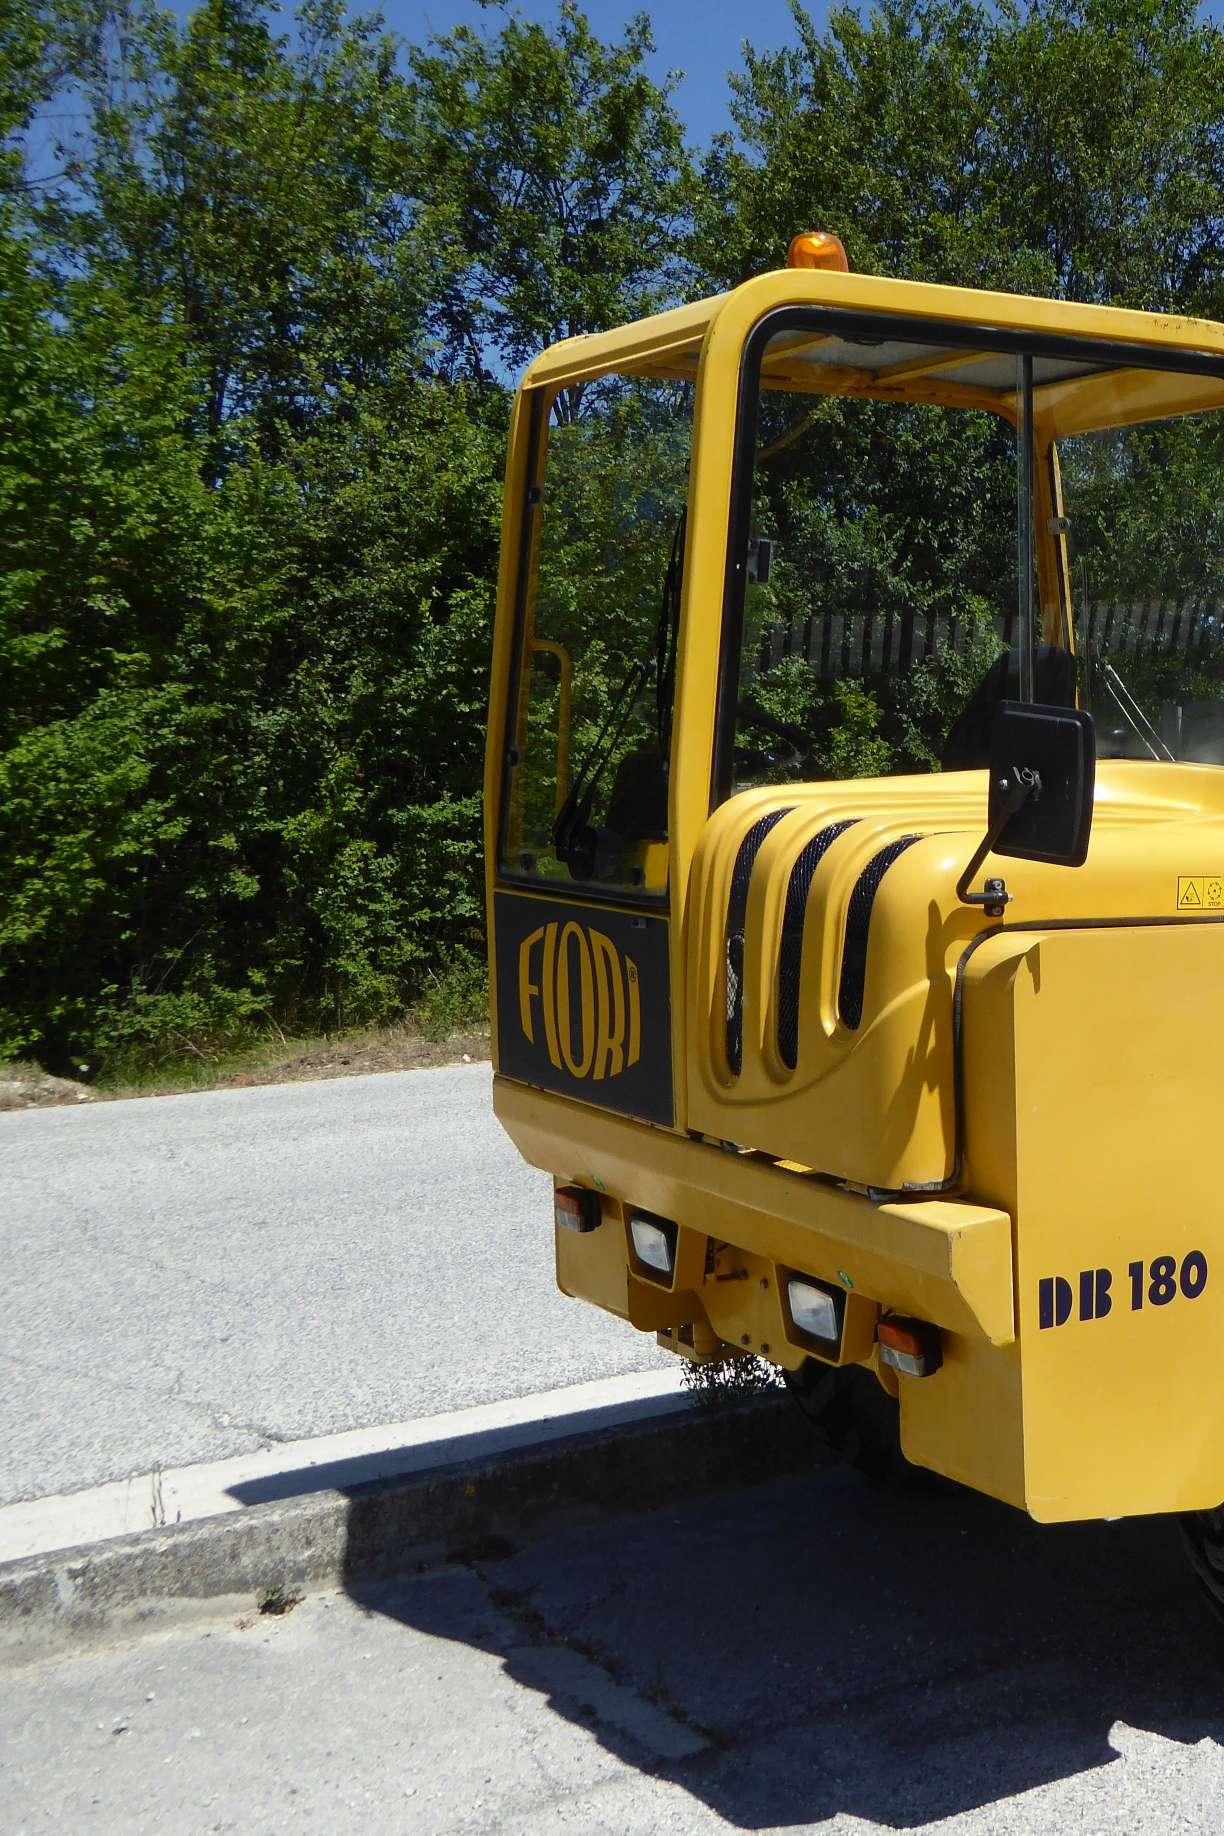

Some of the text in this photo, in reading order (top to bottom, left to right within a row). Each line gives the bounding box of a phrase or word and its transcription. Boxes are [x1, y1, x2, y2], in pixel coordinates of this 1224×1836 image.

[519, 920, 641, 1080] FIORI
[1038, 1250, 1207, 1330] DB 180
